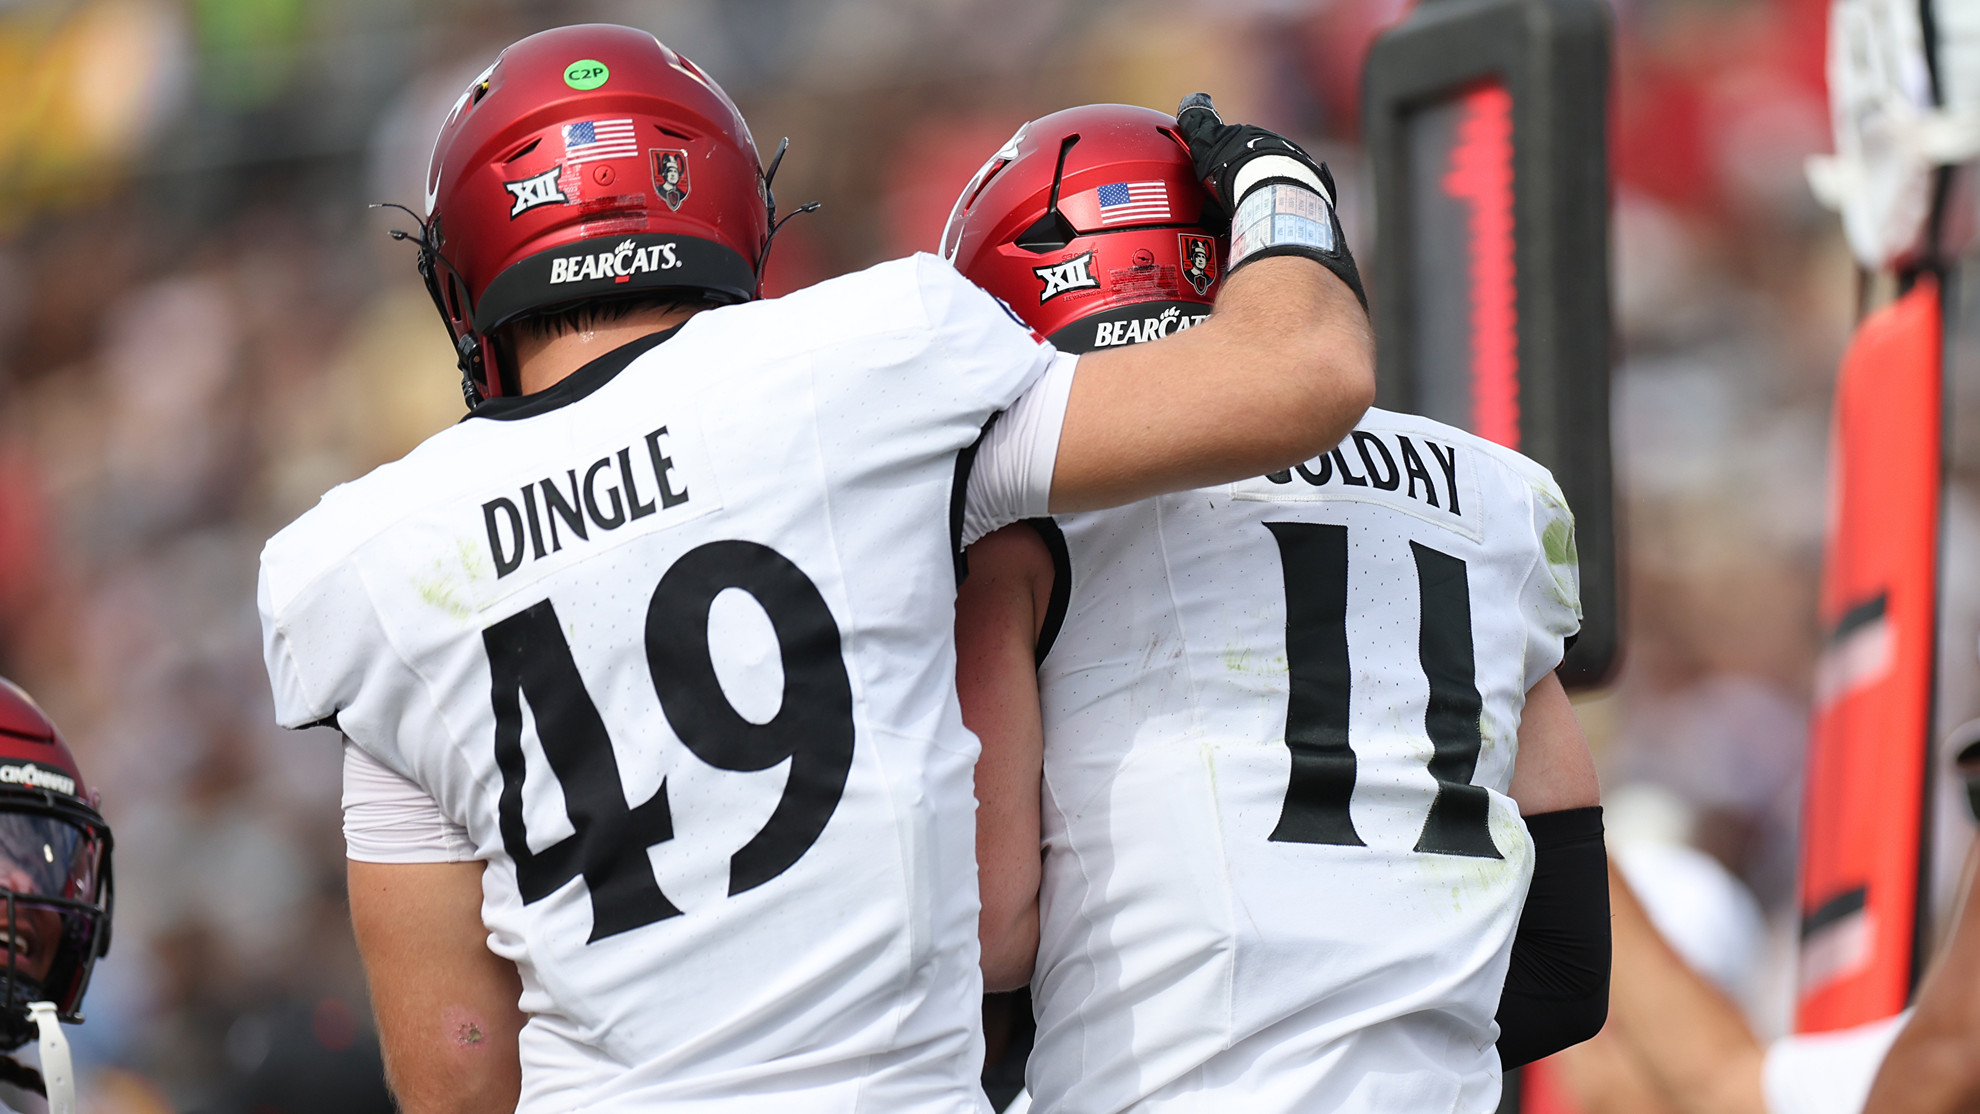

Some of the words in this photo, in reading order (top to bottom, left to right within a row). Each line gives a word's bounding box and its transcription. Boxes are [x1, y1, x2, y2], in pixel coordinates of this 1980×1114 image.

[568, 67, 604, 80] C2P
[506, 165, 566, 218] XII
[1035, 252, 1096, 302] XII
[1094, 306, 1213, 347] BEARCAT
[482, 425, 690, 580] DINGLE
[1264, 430, 1463, 517] OLDAY
[1261, 520, 1506, 860] 11
[482, 538, 856, 946] 49
